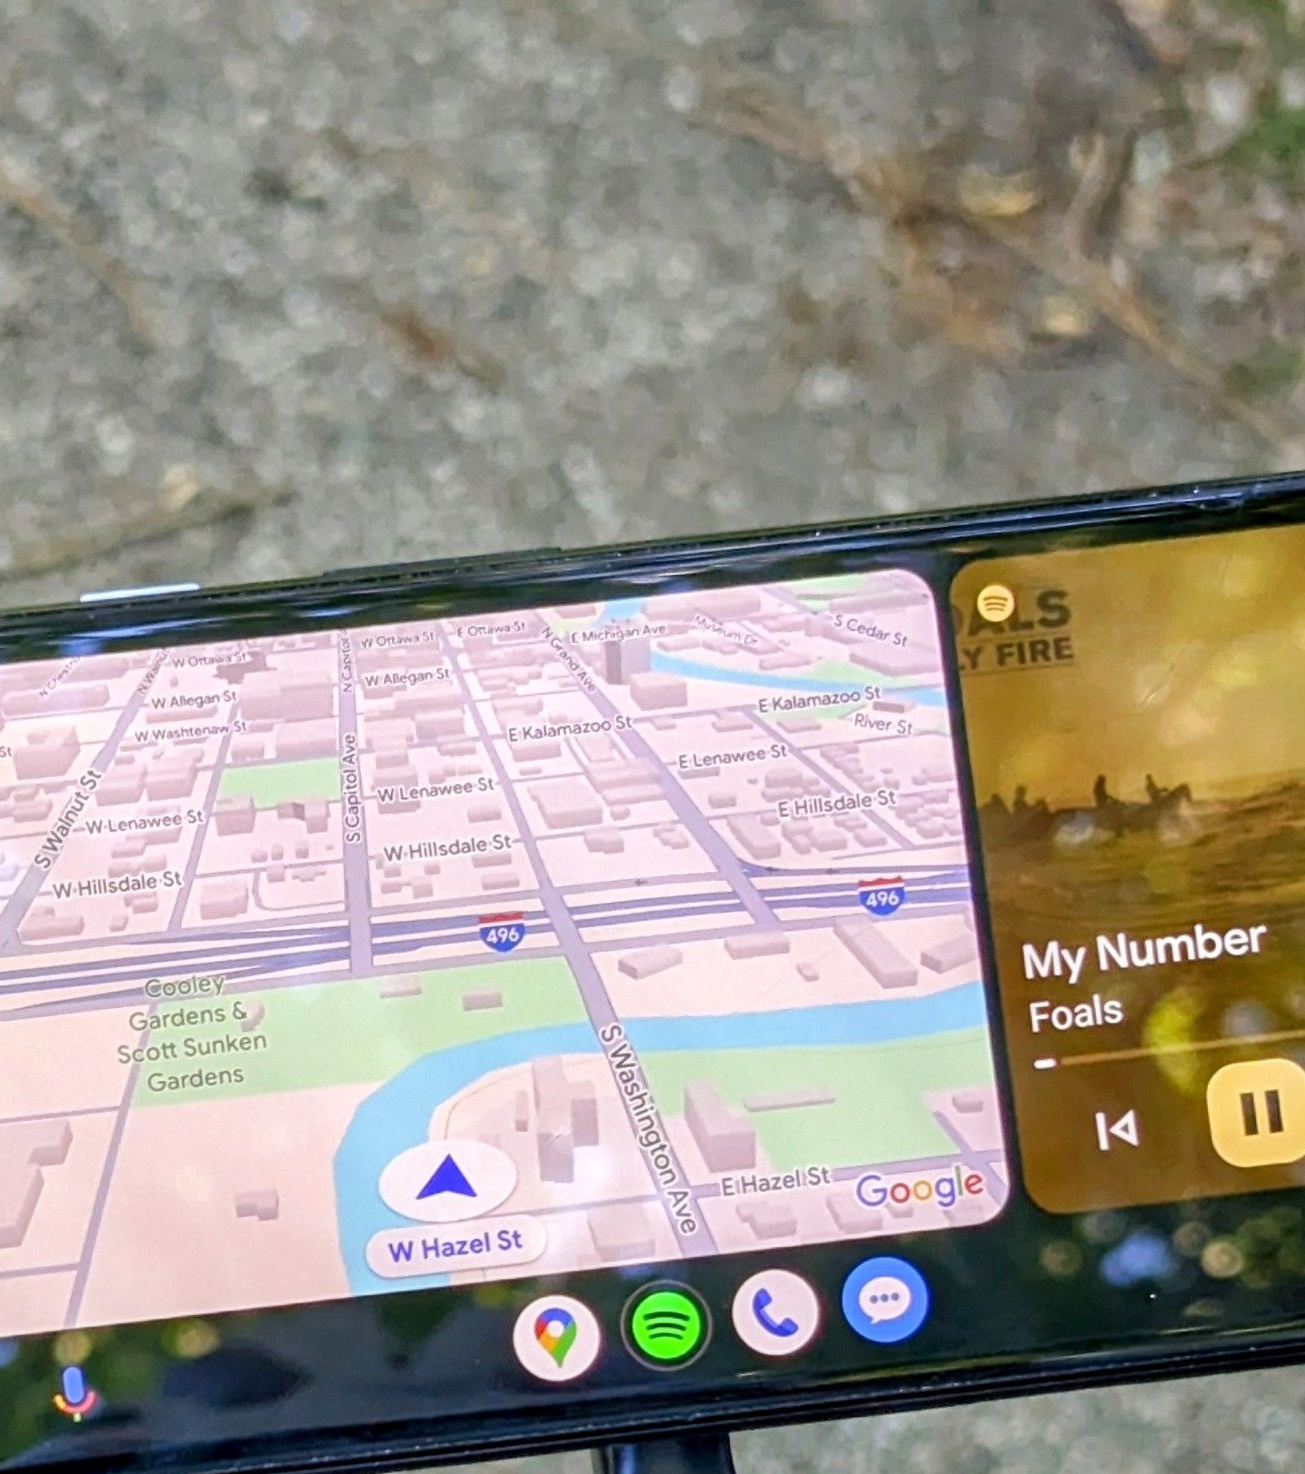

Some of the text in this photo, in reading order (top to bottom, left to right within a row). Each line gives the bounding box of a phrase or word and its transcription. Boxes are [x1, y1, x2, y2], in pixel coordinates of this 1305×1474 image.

[422, 631, 434, 642] St
[513, 621, 525, 632] St
[582, 625, 639, 642] Michigan
[643, 624, 666, 635] Ave
[834, 614, 908, 647] S Cedar St
[550, 637, 580, 672] Grand
[578, 671, 595, 692] Ave
[960, 637, 1074, 669] Y FIRE
[365, 668, 449, 687] W Allegan St
[152, 690, 237, 709] W Allegan St
[759, 686, 881, 713] E Kalamazoo St
[135, 721, 247, 742] W Washtenaw St
[509, 715, 632, 742] E Kalamazoo St
[854, 713, 913, 735] River St
[0, 746, 12, 758] St
[679, 744, 787, 769] E Lenawee St
[343, 734, 361, 842] S Capitol Ave
[378, 777, 494, 802] W Lenawee St
[778, 789, 897, 817] E Hillsdale St
[34, 769, 102, 869] S Walnut St
[86, 809, 204, 834] W Lenawee St
[384, 834, 512, 862] W Hillsdale St
[53, 870, 183, 899] W Hillsdale St
[866, 889, 900, 907] 496
[486, 927, 520, 944] 496
[1022, 923, 1267, 984] My Number
[145, 976, 225, 997] Cooley
[129, 1001, 247, 1031] Gardens &
[1029, 993, 1124, 1033] Foals
[117, 1034, 267, 1064] Scott Sunken
[147, 1068, 244, 1092] Gardens
[601, 1024, 697, 1234] S Washington Ave
[722, 1166, 831, 1196] E Hazel St
[855, 1165, 984, 1208] Google
[388, 1229, 523, 1263] W Hazel St
